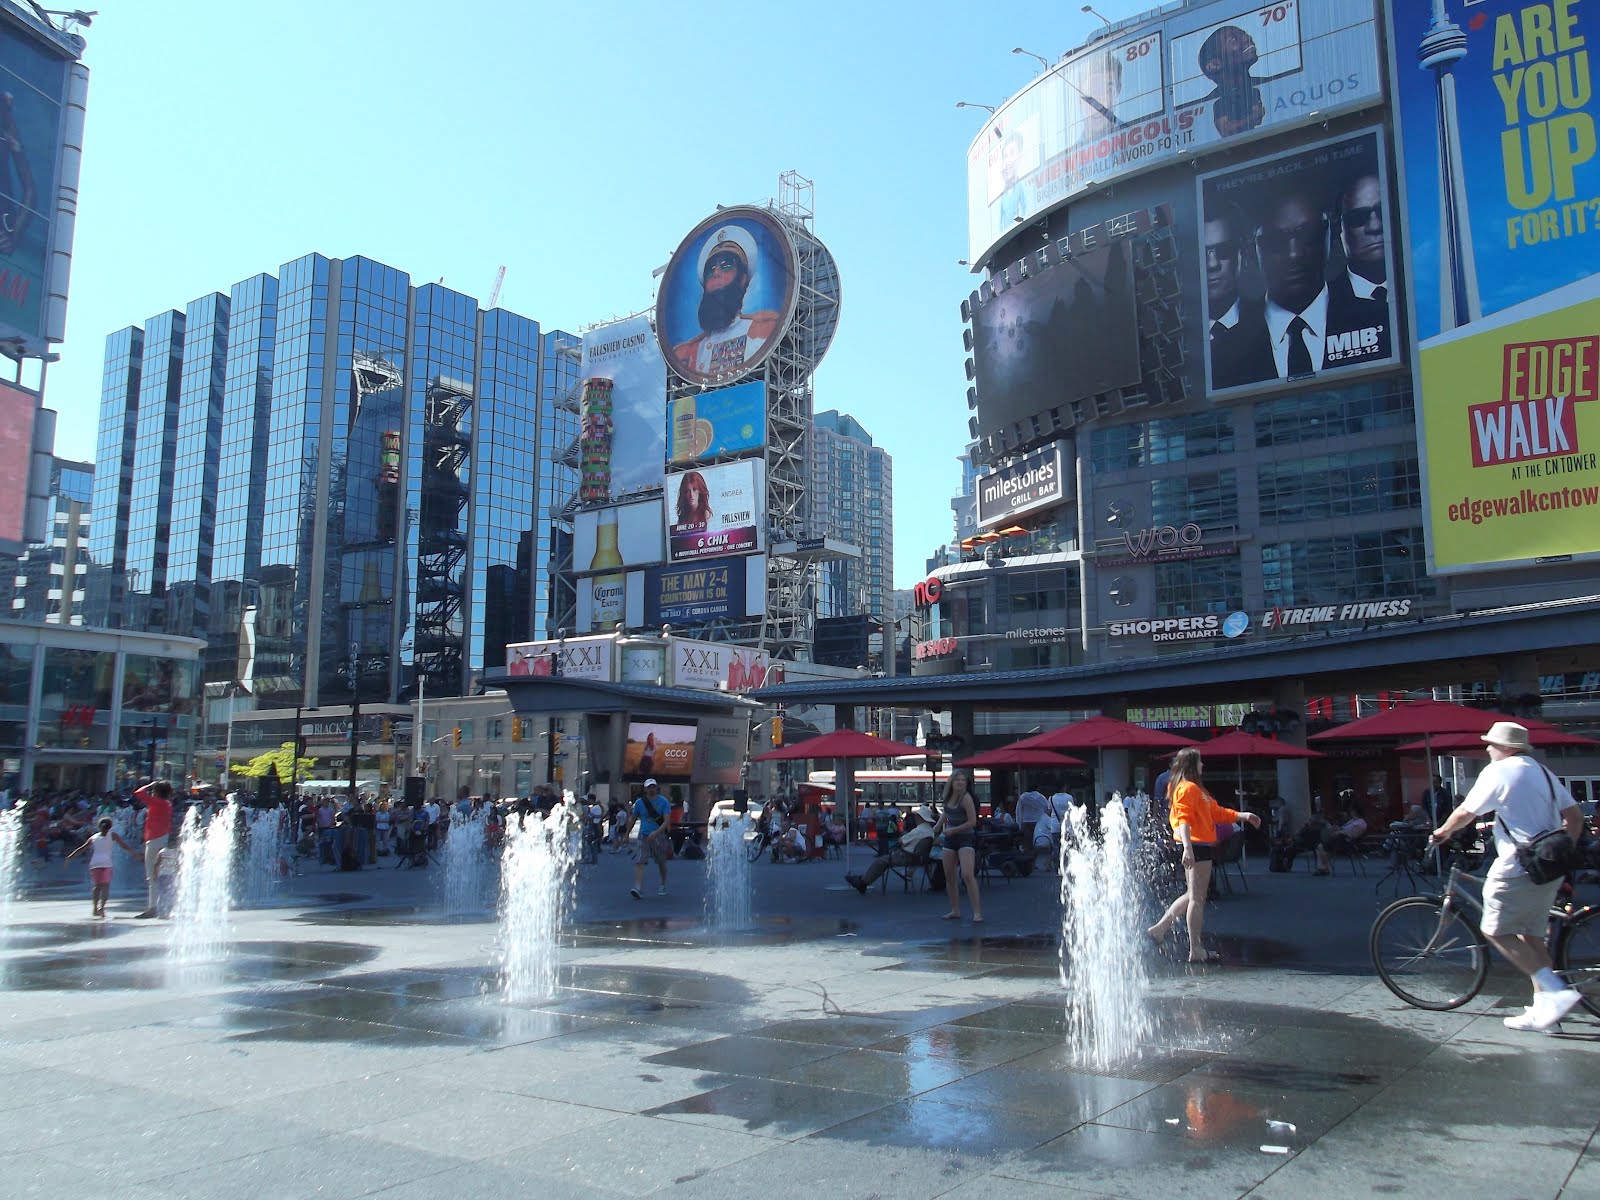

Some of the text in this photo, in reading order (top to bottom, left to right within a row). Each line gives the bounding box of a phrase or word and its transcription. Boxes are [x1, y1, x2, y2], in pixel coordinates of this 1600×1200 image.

[1493, 0, 1585, 71] ARE
[1274, 73, 1359, 112] AQUOS
[1492, 50, 1592, 126] YOU
[1501, 112, 1597, 211] UP
[1507, 196, 1600, 249] FOR IT?
[589, 333, 646, 358] FALLSVIEW CASINO
[1328, 345, 1380, 361] 05.25.12
[1509, 341, 1593, 402] EDGE
[1473, 396, 1570, 462] WALK
[1512, 453, 1597, 481] AT THE CN TOWER
[985, 462, 1054, 504] milestones
[1010, 491, 1032, 507] GRILL
[1448, 486, 1600, 525] edgewalkcntow
[676, 523, 688, 532] JUNE
[697, 534, 729, 547] 6 CHIX
[1123, 523, 1202, 558] WOO
[661, 569, 728, 592] THE MAY 2-4
[594, 586, 624, 601] Corona
[601, 598, 619, 608] Extra
[660, 590, 705, 604] COUNTDOWN
[707, 588, 714, 599] IS
[1109, 615, 1219, 636] SHOPPERS
[1262, 599, 1412, 631] EXTREME FITNESS
[1005, 627, 1065, 640] milestones
[1152, 629, 1219, 641] DRUG MART
[563, 645, 602, 667] XXI
[682, 648, 720, 670] XXI
[563, 665, 602, 673] OREVER
[681, 667, 720, 676] FOREVER
[1173, 720, 1188, 728] SIP
[664, 748, 688, 758] ecco
